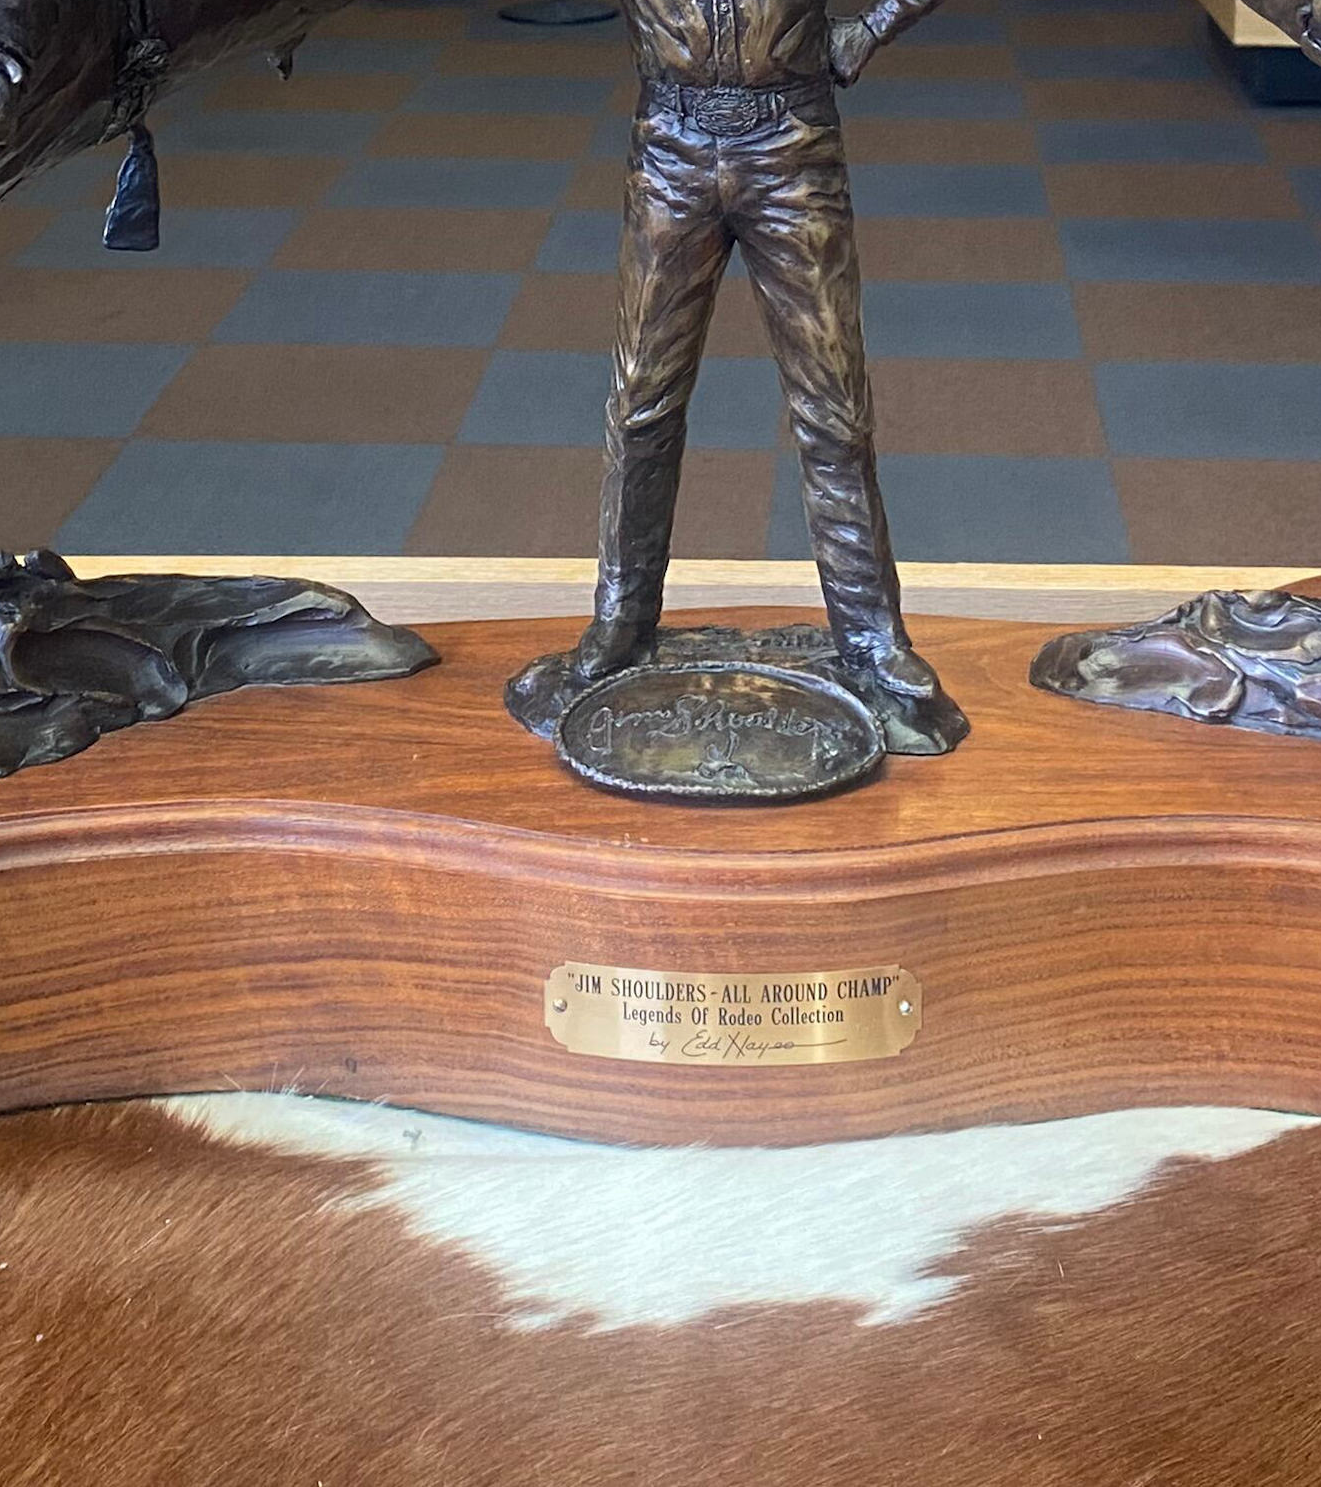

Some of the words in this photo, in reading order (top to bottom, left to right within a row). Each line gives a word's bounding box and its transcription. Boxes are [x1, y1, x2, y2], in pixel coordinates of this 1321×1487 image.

[567, 972, 601, 994] "JIM
[761, 983, 828, 1004] AROUND
[837, 975, 899, 999] CHAMP"
[623, 1001, 682, 1026] Legends
[691, 1006, 708, 1025] Of
[718, 1007, 762, 1026] Rodeo
[771, 1005, 844, 1026] Collection
[648, 1031, 670, 1054] by
